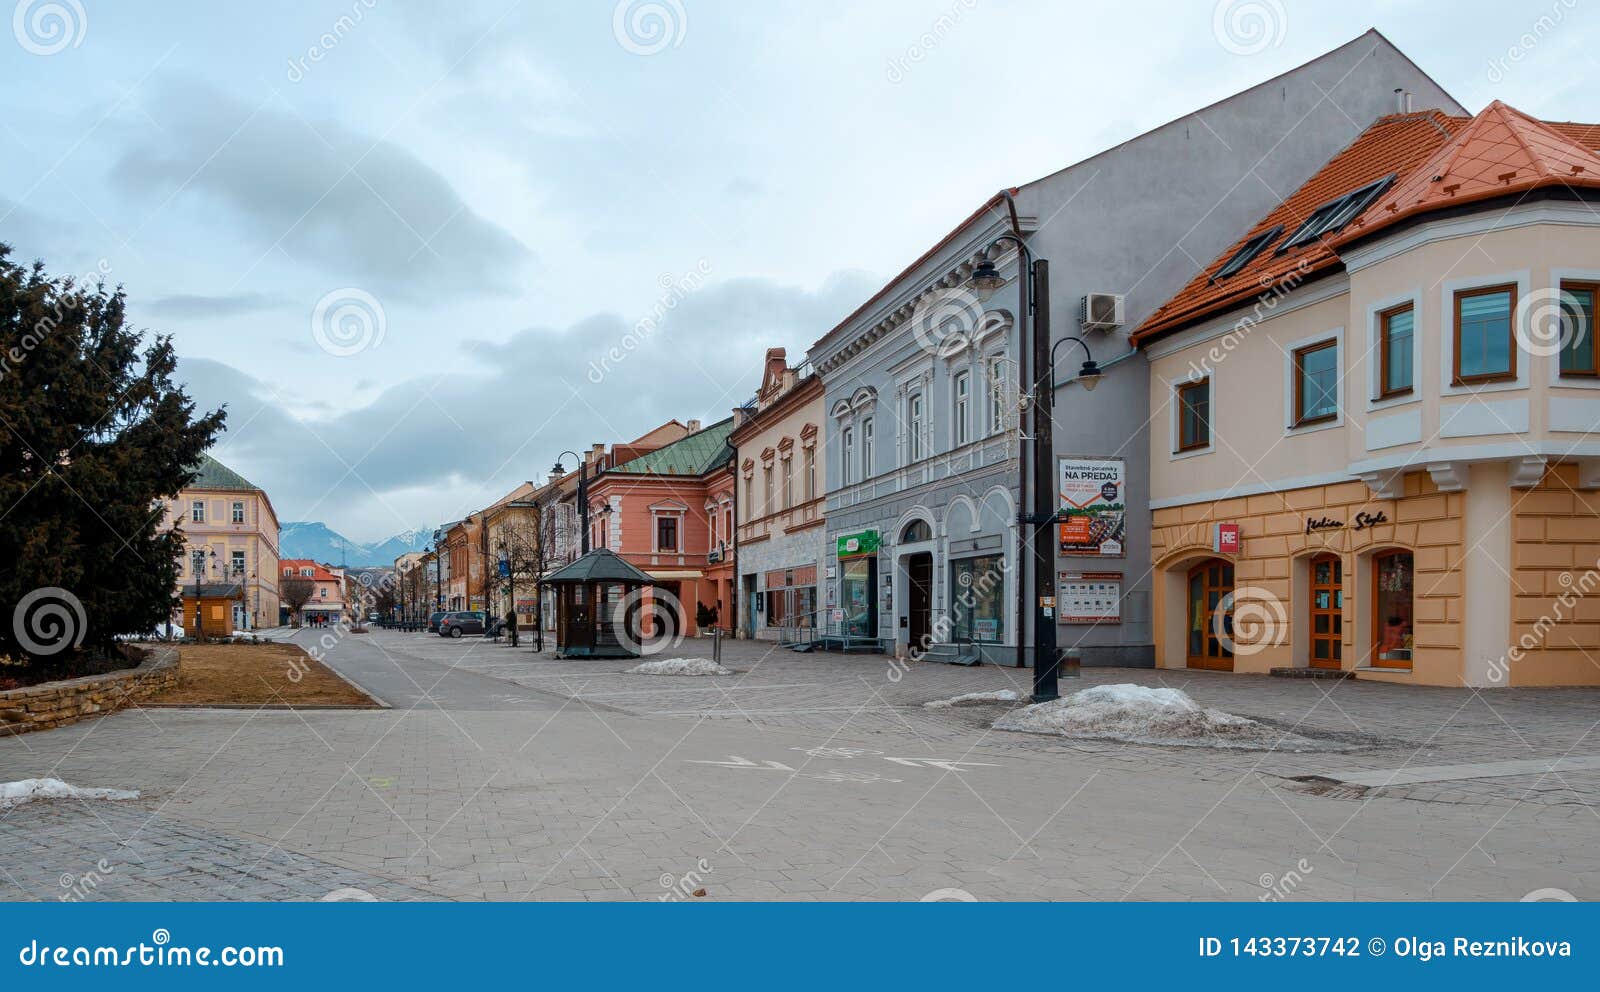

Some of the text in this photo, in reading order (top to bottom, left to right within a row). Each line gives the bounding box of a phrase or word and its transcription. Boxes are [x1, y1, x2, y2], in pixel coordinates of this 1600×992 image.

[1065, 471, 1118, 481] NA PREDAJ
[1306, 511, 1388, 535] Italian Style
[1221, 531, 1236, 545] RE
